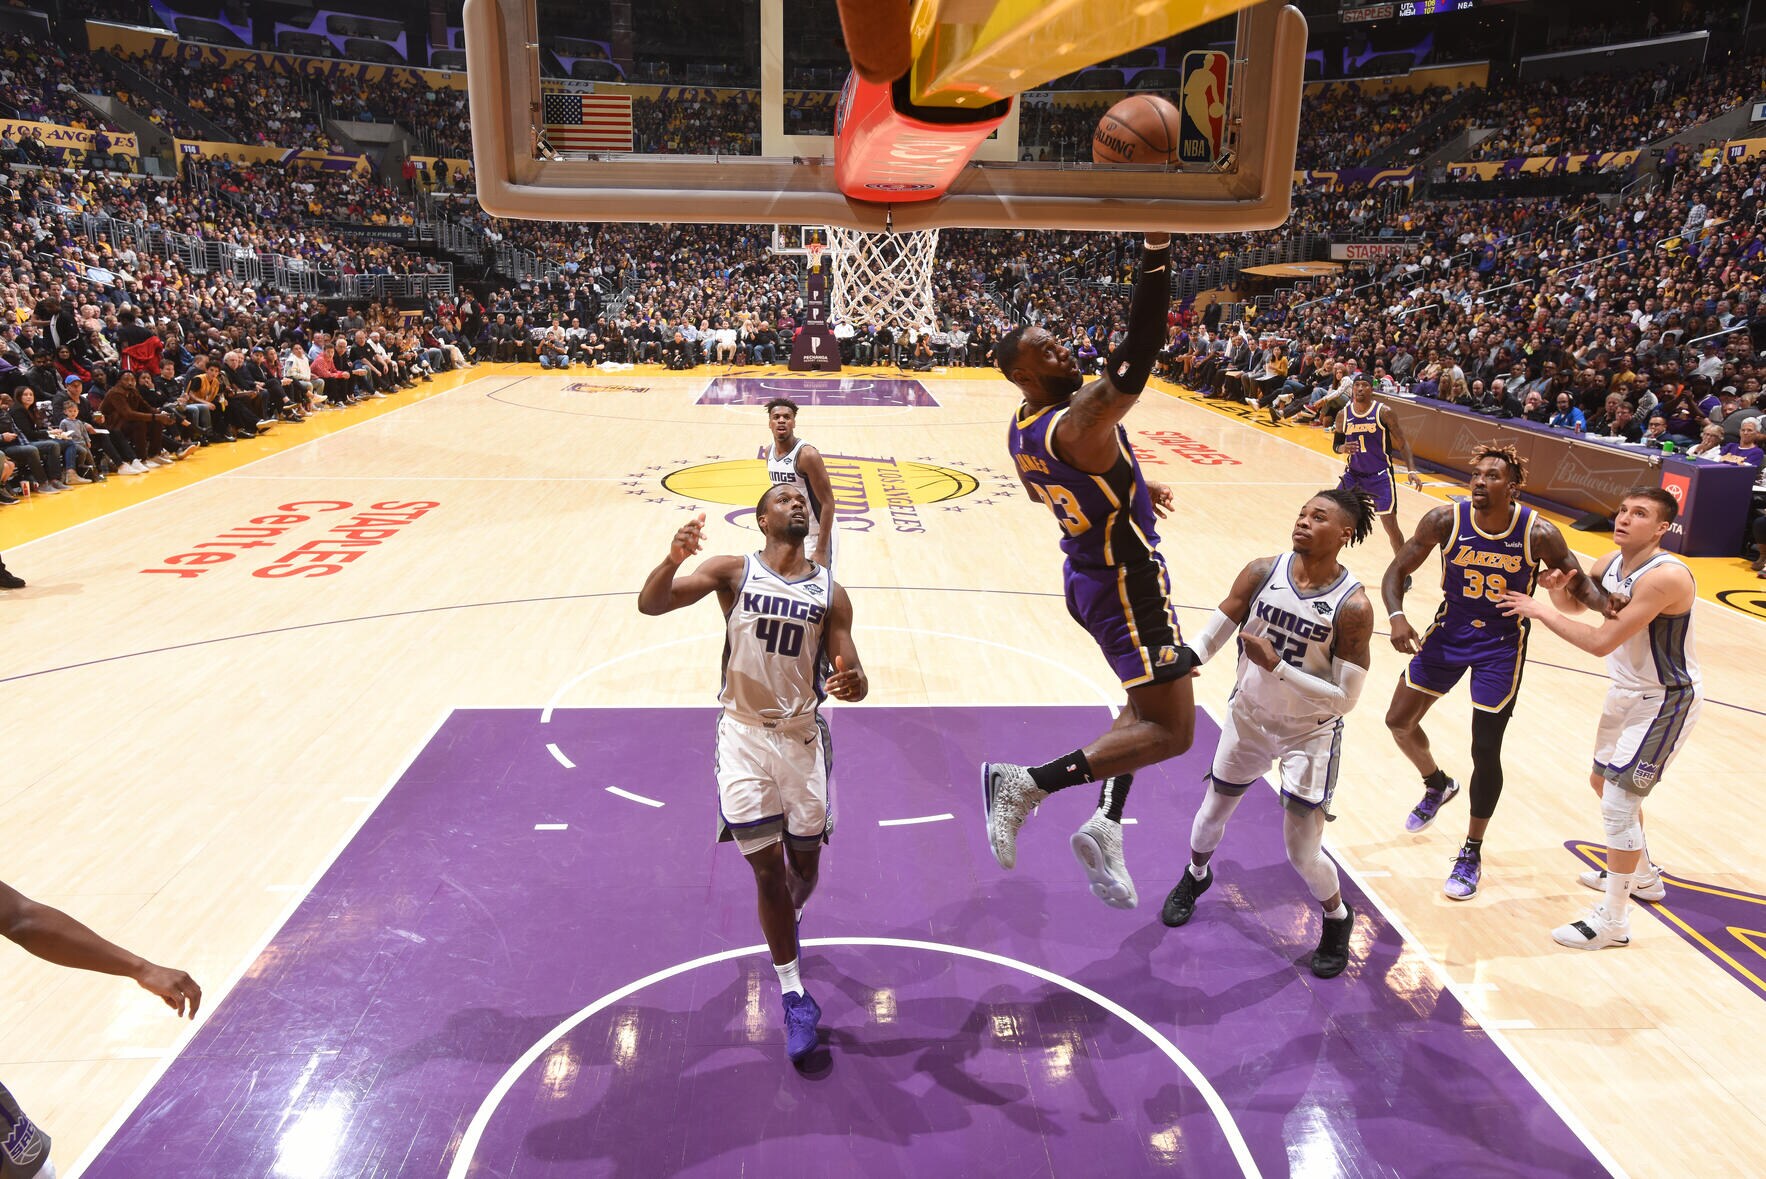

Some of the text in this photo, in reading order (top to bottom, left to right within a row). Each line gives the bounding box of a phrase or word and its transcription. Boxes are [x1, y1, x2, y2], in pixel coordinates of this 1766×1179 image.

[1343, 6, 1392, 21] STAPLES
[1400, 2, 1414, 10] UTA
[1424, 7, 1435, 15] 107
[1458, 1, 1473, 9] NBA
[152, 37, 428, 87] LOS ANGELES
[6, 124, 135, 148] LOS ANGES
[1095, 126, 1136, 160] PALDING
[1183, 139, 1206, 157] NBA
[1346, 244, 1401, 259] STAPL
[1138, 430, 1243, 466] STAPLES
[1358, 435, 1367, 453] 1
[877, 467, 926, 534] LOS ANGELES
[138, 500, 354, 578] Center
[252, 500, 440, 578] STAPLES
[1450, 545, 1522, 573] LAKERS
[1462, 568, 1507, 602] 39
[743, 592, 826, 625] KINGS
[1256, 600, 1332, 643] KINGS
[755, 617, 805, 658] 40
[1266, 627, 1309, 668] 22
